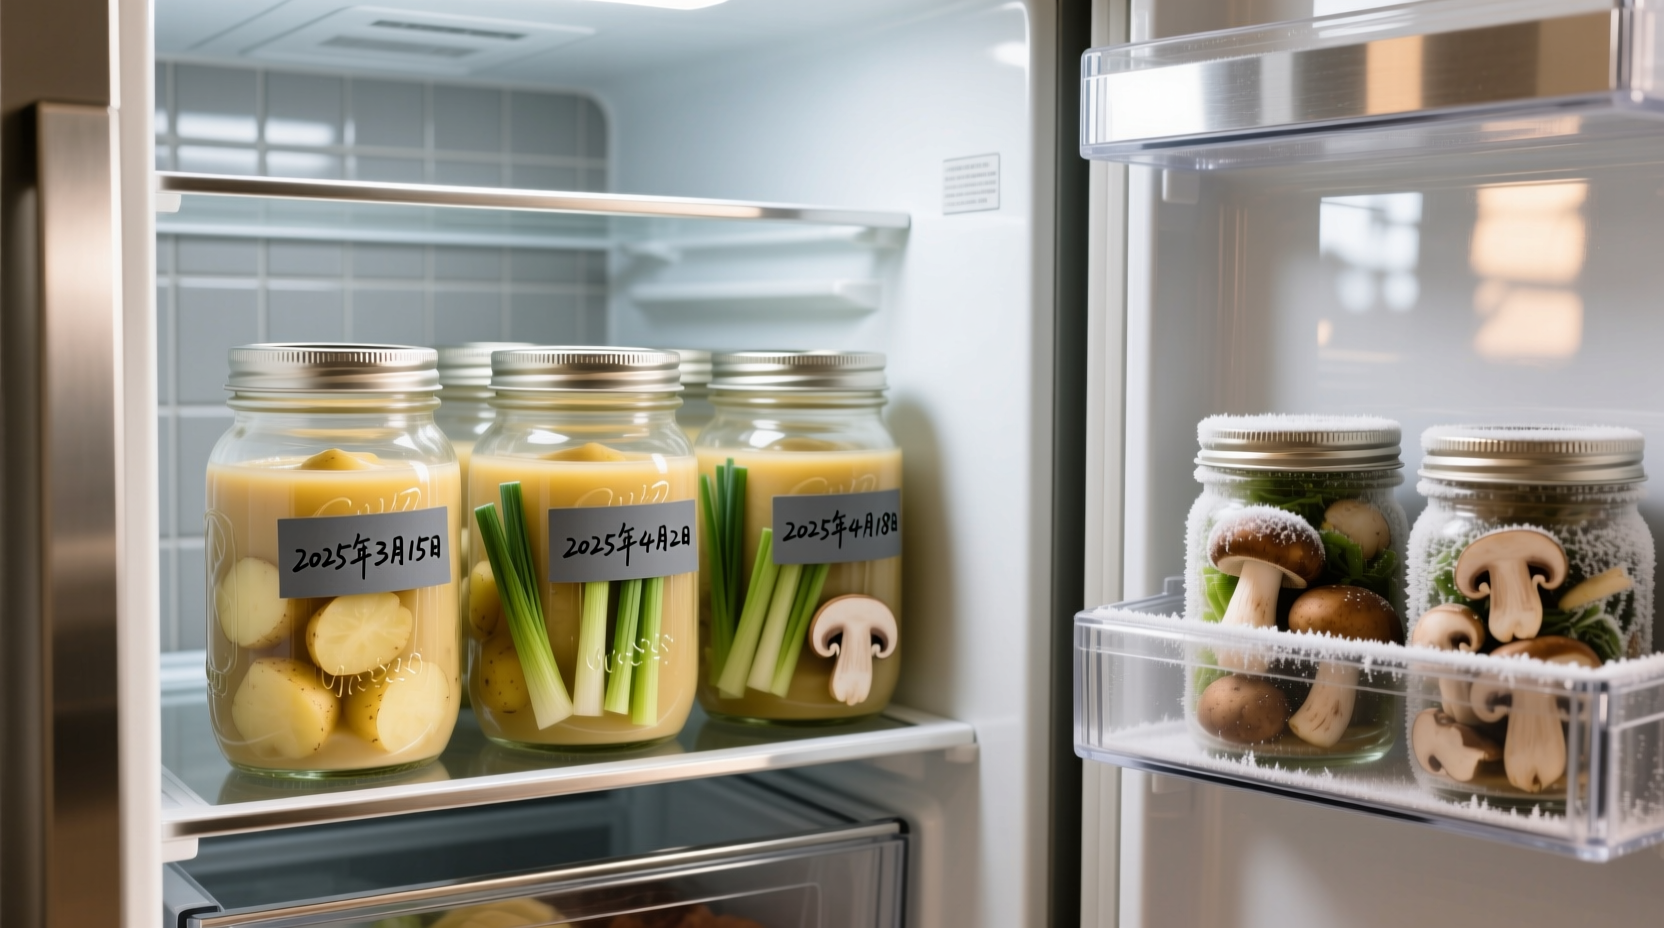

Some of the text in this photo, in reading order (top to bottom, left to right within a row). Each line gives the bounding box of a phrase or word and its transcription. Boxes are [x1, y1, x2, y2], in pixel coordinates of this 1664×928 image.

[562, 522, 691, 567] 2025年4月2日
[782, 509, 898, 549] 2025年4月18日
[292, 533, 441, 580] 2025年3月15日
